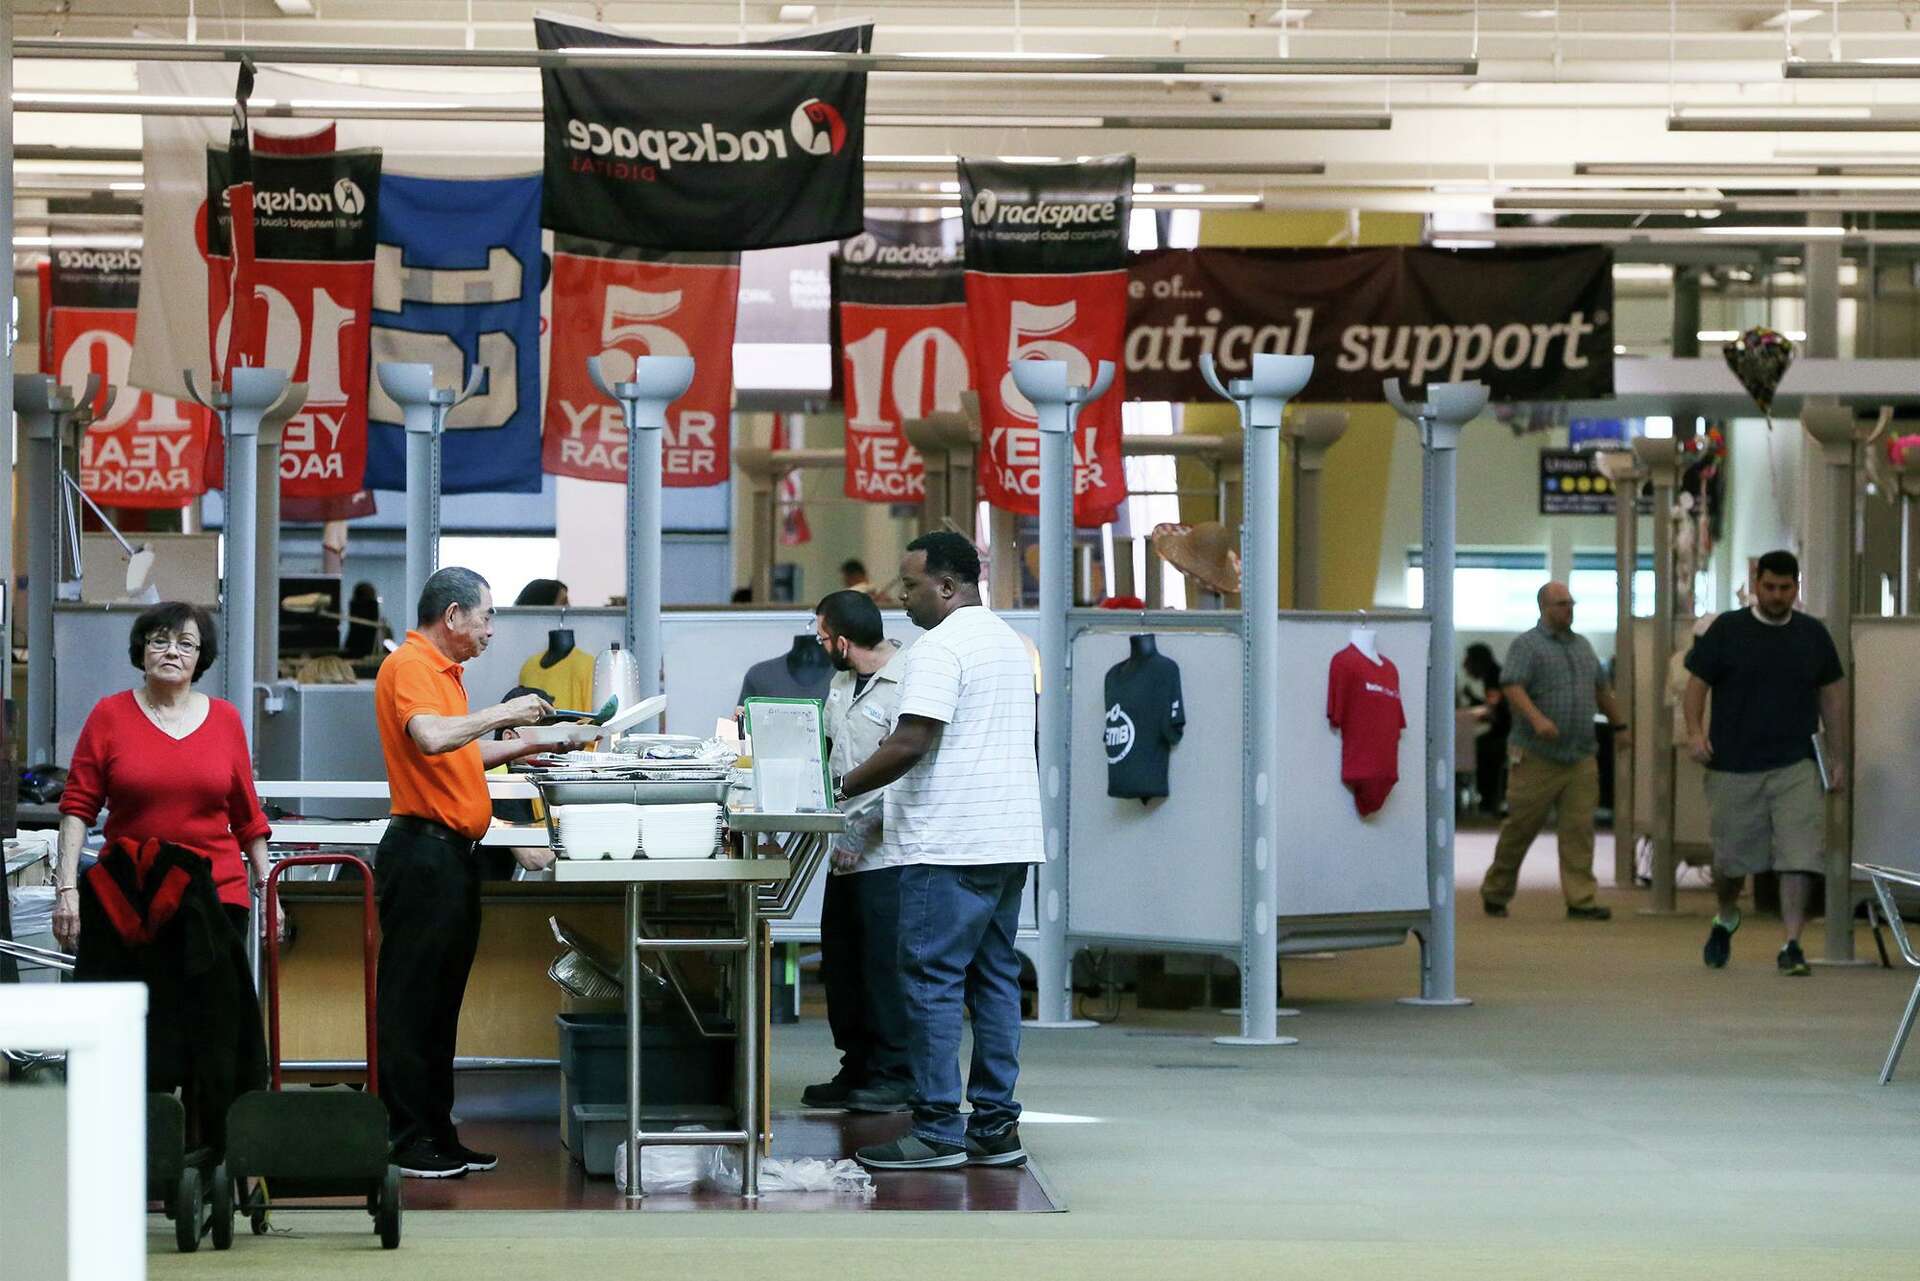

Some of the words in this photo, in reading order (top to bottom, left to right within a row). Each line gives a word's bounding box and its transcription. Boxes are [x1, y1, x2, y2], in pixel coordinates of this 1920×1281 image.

[997, 201, 1115, 228] rackspace
[996, 231, 1040, 242] managed
[1041, 230, 1070, 241] cloud
[601, 284, 693, 388] 5
[1125, 307, 1315, 372] atical
[1336, 309, 1595, 384] support
[1000, 300, 1093, 422] 5
[845, 327, 971, 433] 10
[561, 439, 716, 475] RACER
[853, 437, 924, 471] YEA
[855, 471, 926, 495] RACK
[997, 462, 1107, 495] ACER
